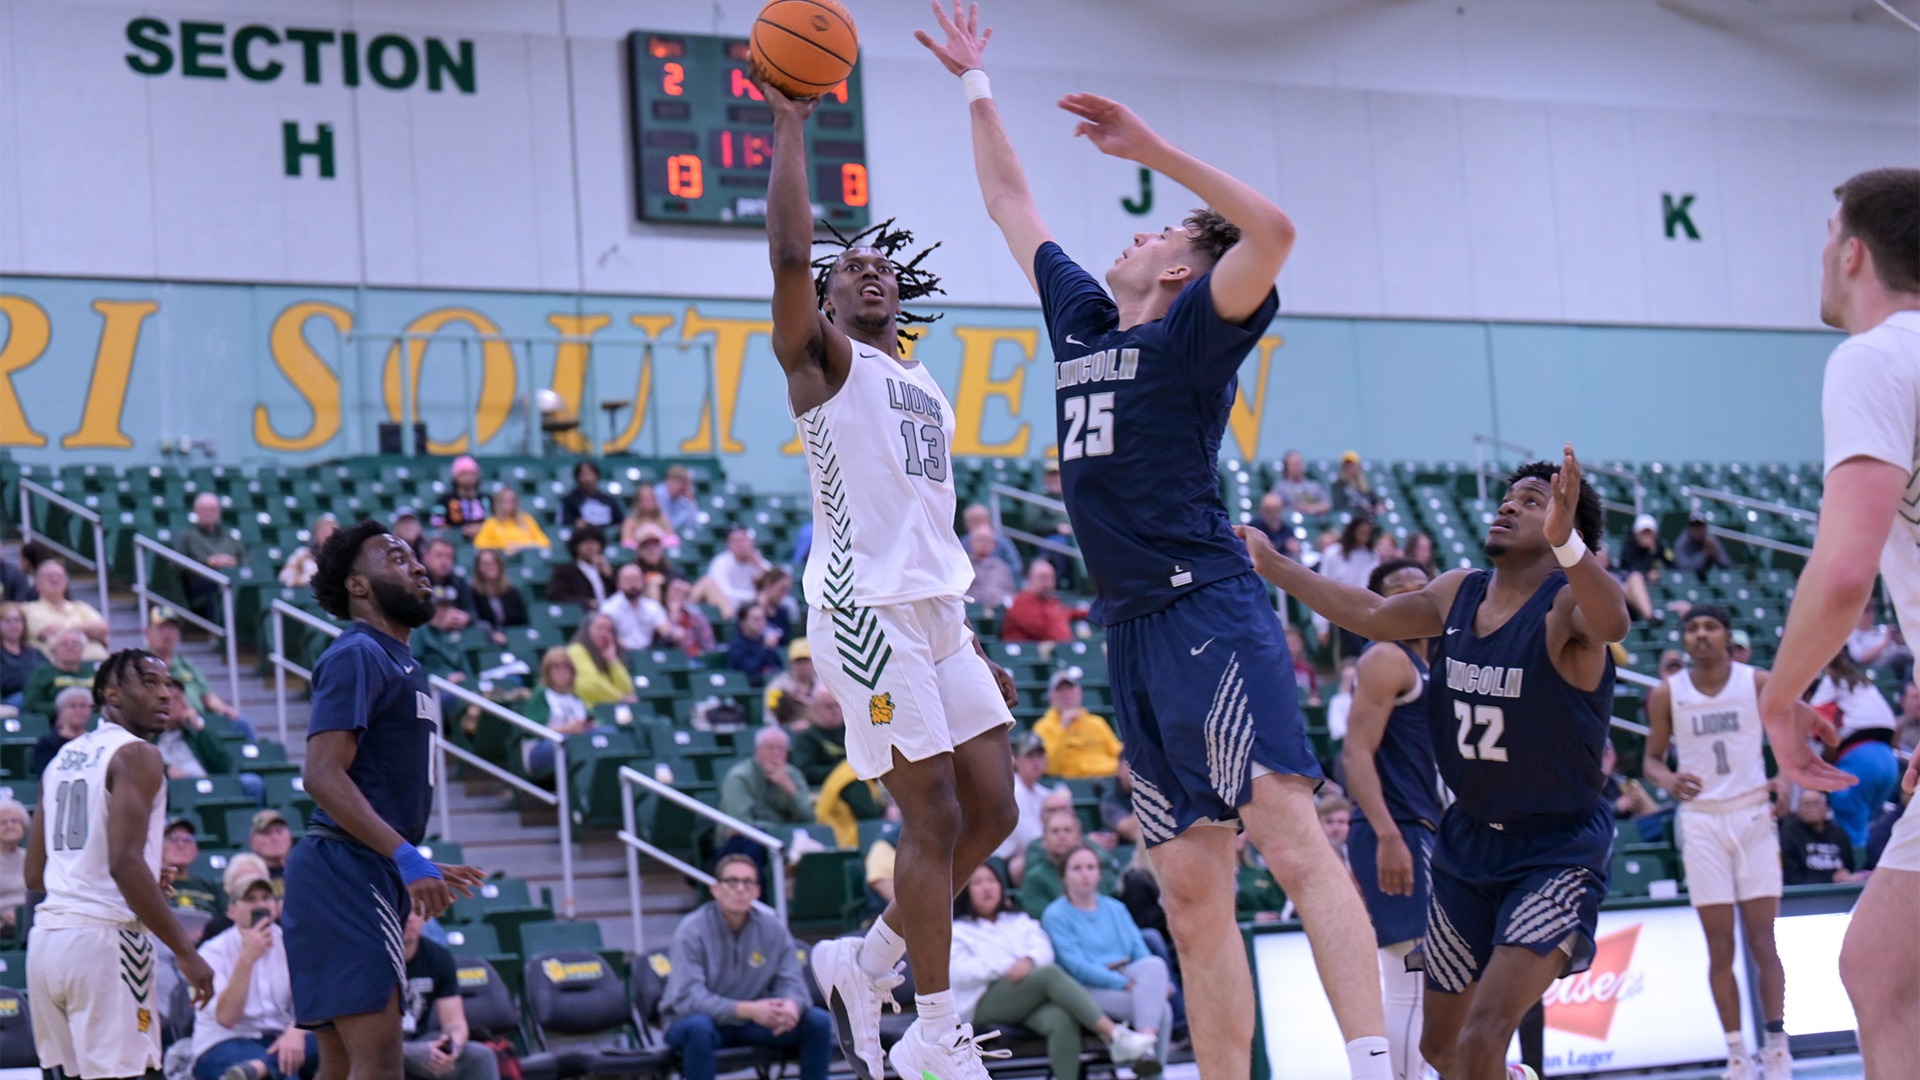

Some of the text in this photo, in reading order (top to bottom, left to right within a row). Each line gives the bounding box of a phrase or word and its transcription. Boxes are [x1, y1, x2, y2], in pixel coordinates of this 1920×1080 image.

[124, 17, 477, 95] SECTION
[282, 120, 336, 179] H
[1120, 166, 1153, 217] J
[1661, 193, 1701, 241] K
[1054, 348, 1140, 391] LINCOLN
[886, 377, 944, 428] LIONS
[1062, 391, 1116, 462] 25
[900, 419, 947, 483] 13
[1453, 699, 1509, 763] 22
[1712, 740, 1731, 776] 1
[53, 778, 88, 852] 10
